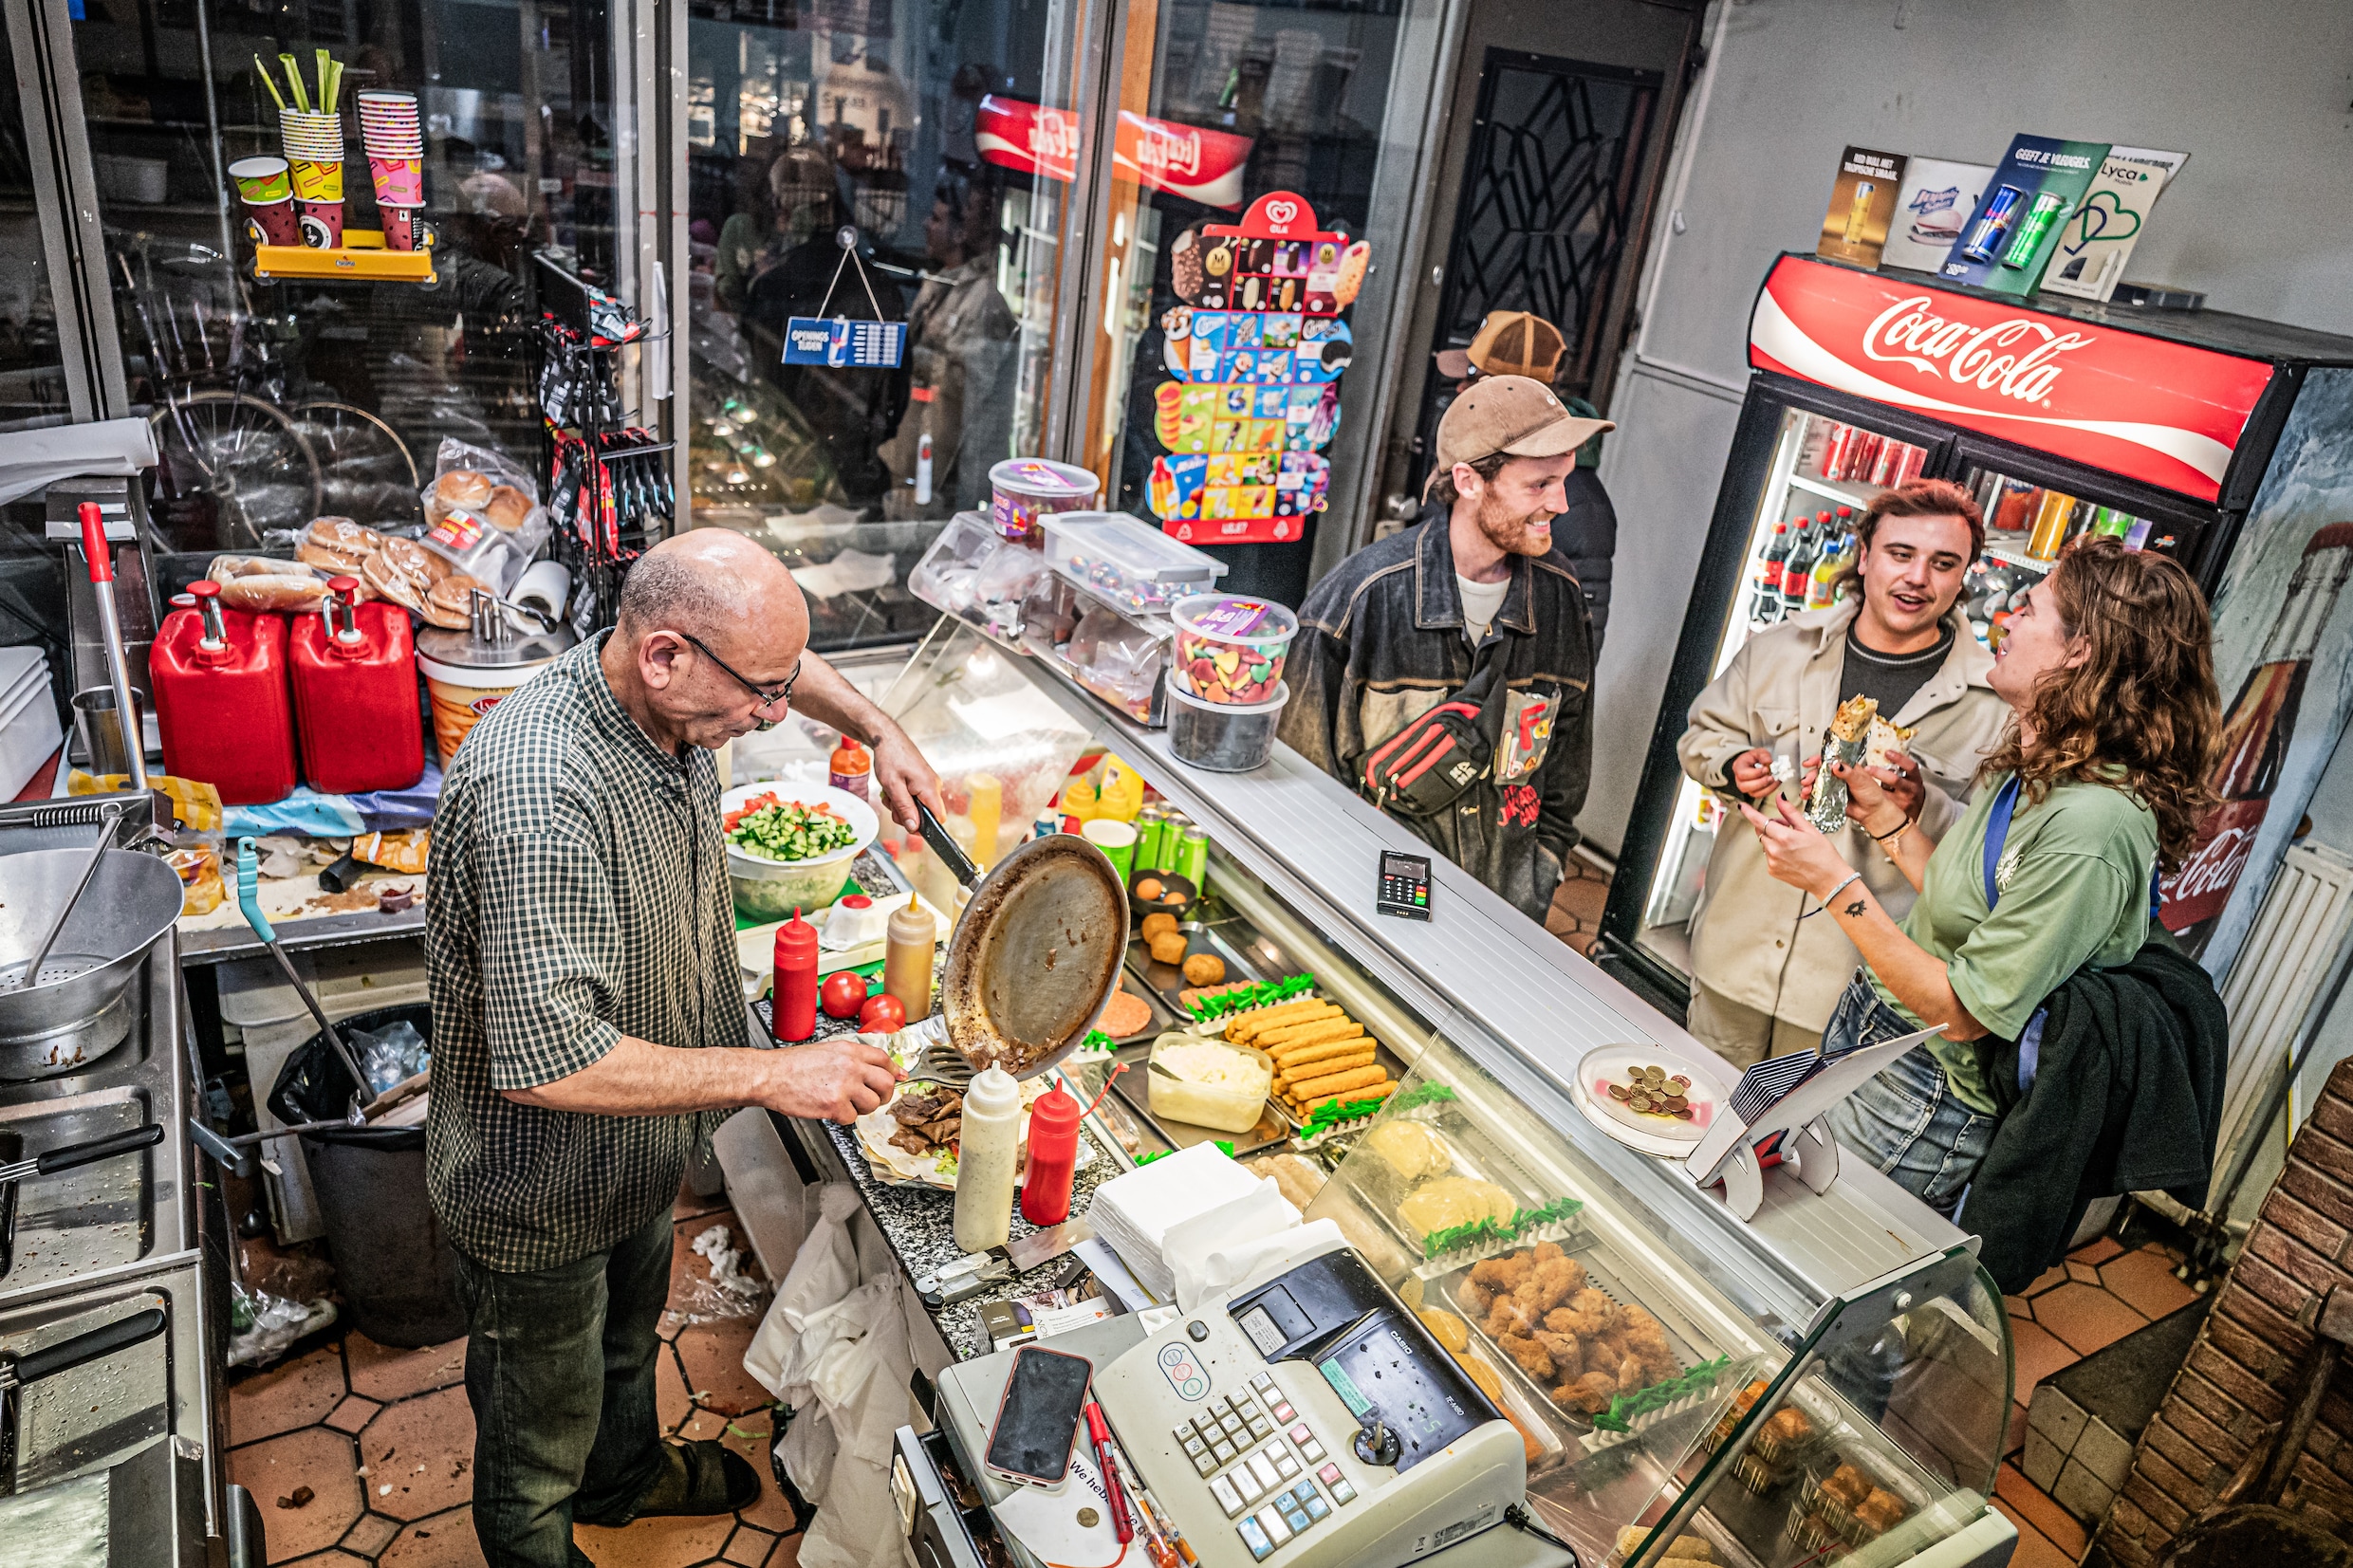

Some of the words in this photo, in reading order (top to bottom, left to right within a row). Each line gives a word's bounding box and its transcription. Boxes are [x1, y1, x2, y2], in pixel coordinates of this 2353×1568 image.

[2014, 147, 2041, 163] GEEFT
[2039, 151, 2051, 164] JE
[2100, 162, 2139, 180] Lyca
[1862, 296, 2097, 402] Coca-Cola
[1390, 1330, 1413, 1356] CASIO
[1180, 1426, 1189, 1434] 0
[1189, 1440, 1200, 1451] 00
[1227, 1418, 1235, 1427] 5
[1238, 1434, 1247, 1443] 6
[1069, 1460, 1087, 1480] We
